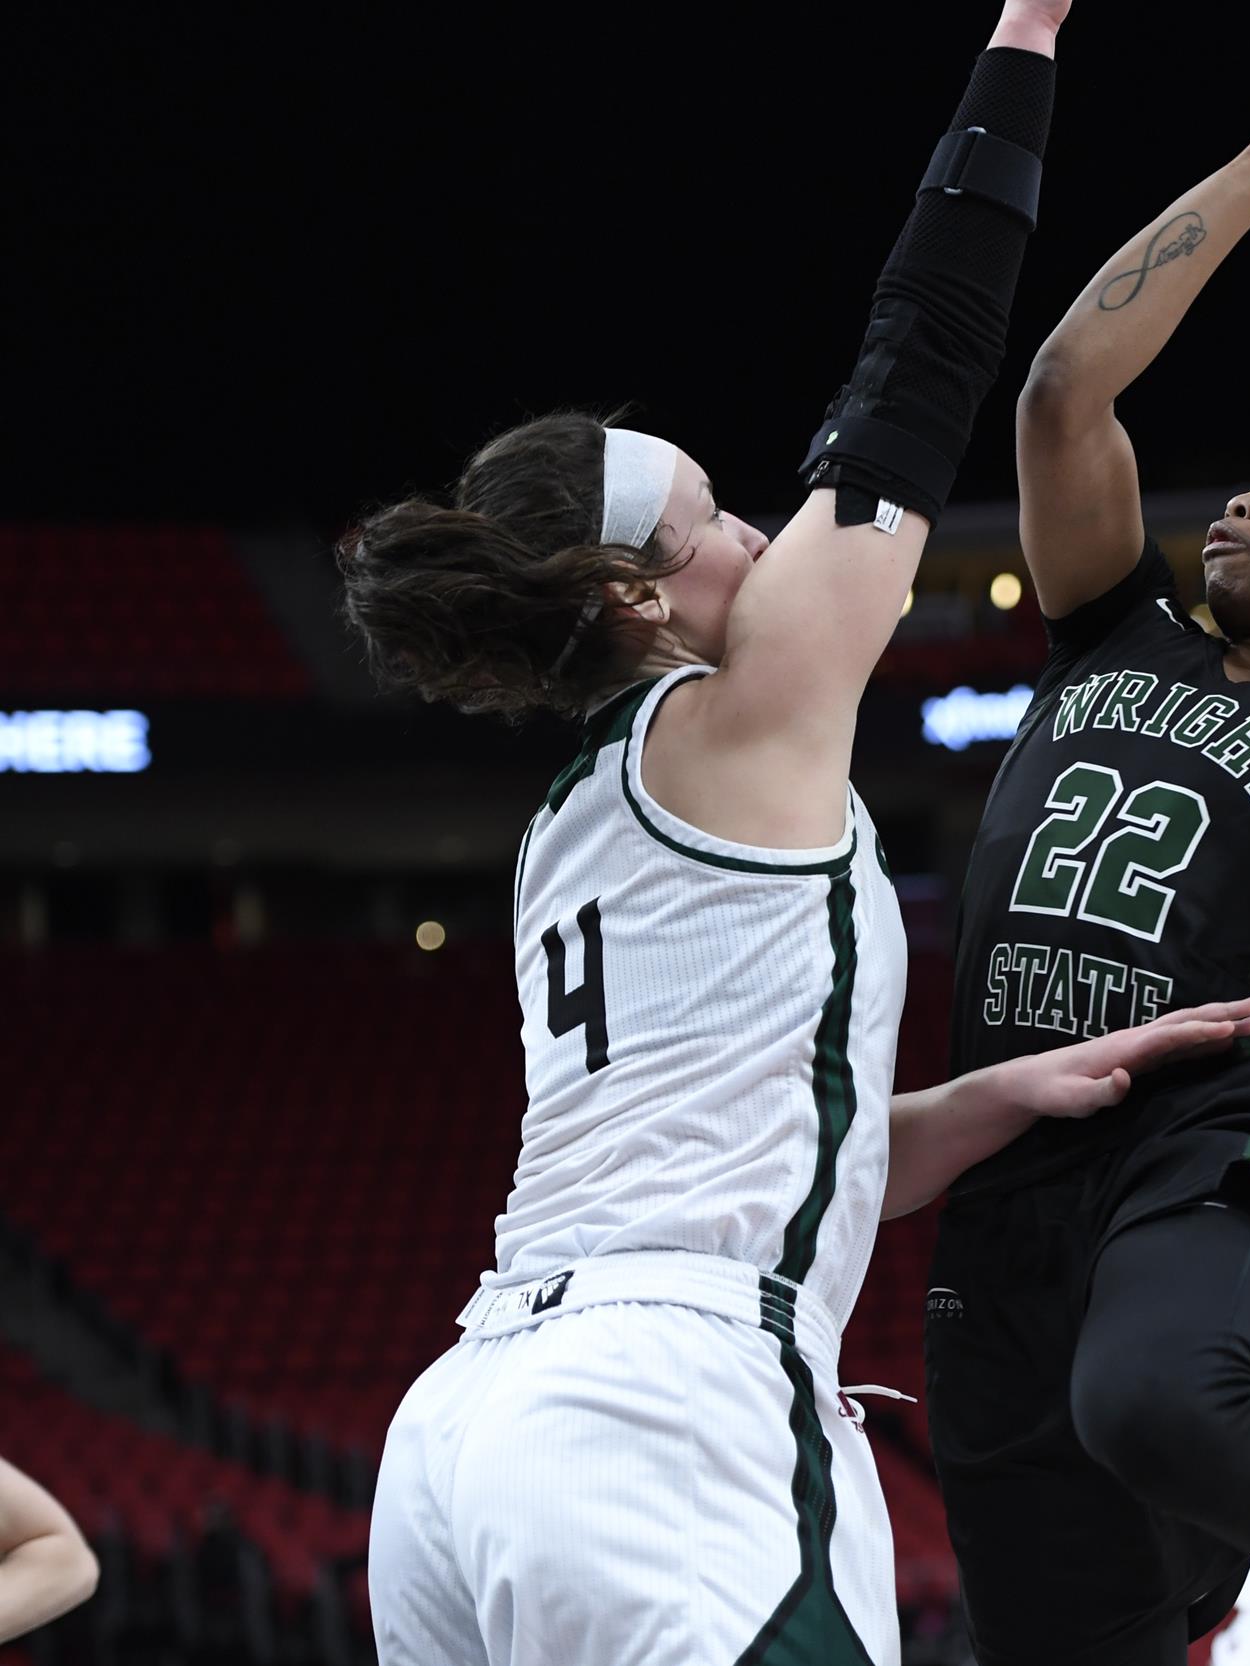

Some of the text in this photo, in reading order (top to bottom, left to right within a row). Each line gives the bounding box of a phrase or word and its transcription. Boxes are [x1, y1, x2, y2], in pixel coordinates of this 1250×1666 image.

[1009, 762, 1211, 943] 22
[540, 896, 610, 1075] 4
[983, 943, 1174, 1039] STATE
